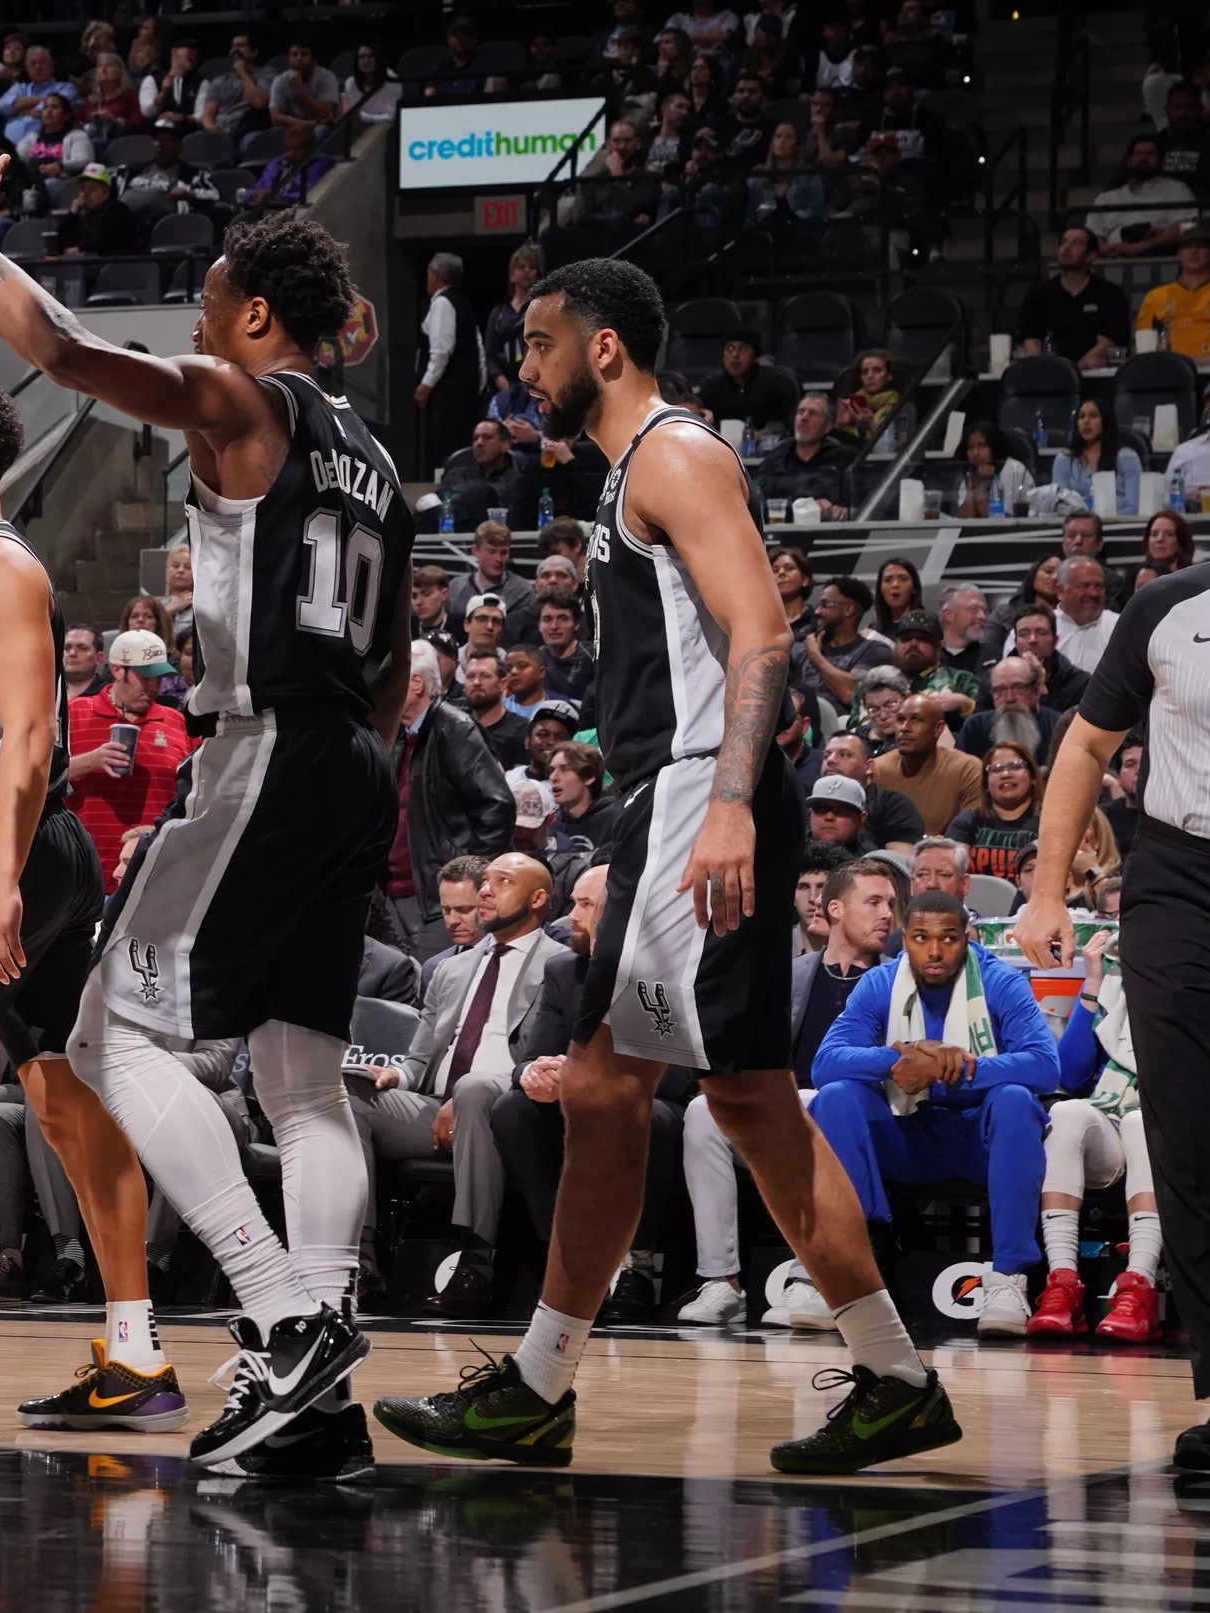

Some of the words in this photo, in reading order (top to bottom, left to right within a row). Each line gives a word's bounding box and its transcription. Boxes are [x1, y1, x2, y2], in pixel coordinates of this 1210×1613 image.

[483, 201, 519, 229] EXIT
[295, 506, 385, 657] 10
[968, 847, 1020, 878] SPUR
[342, 1045, 408, 1068] Fros
[294, 1320, 308, 1334] 10
